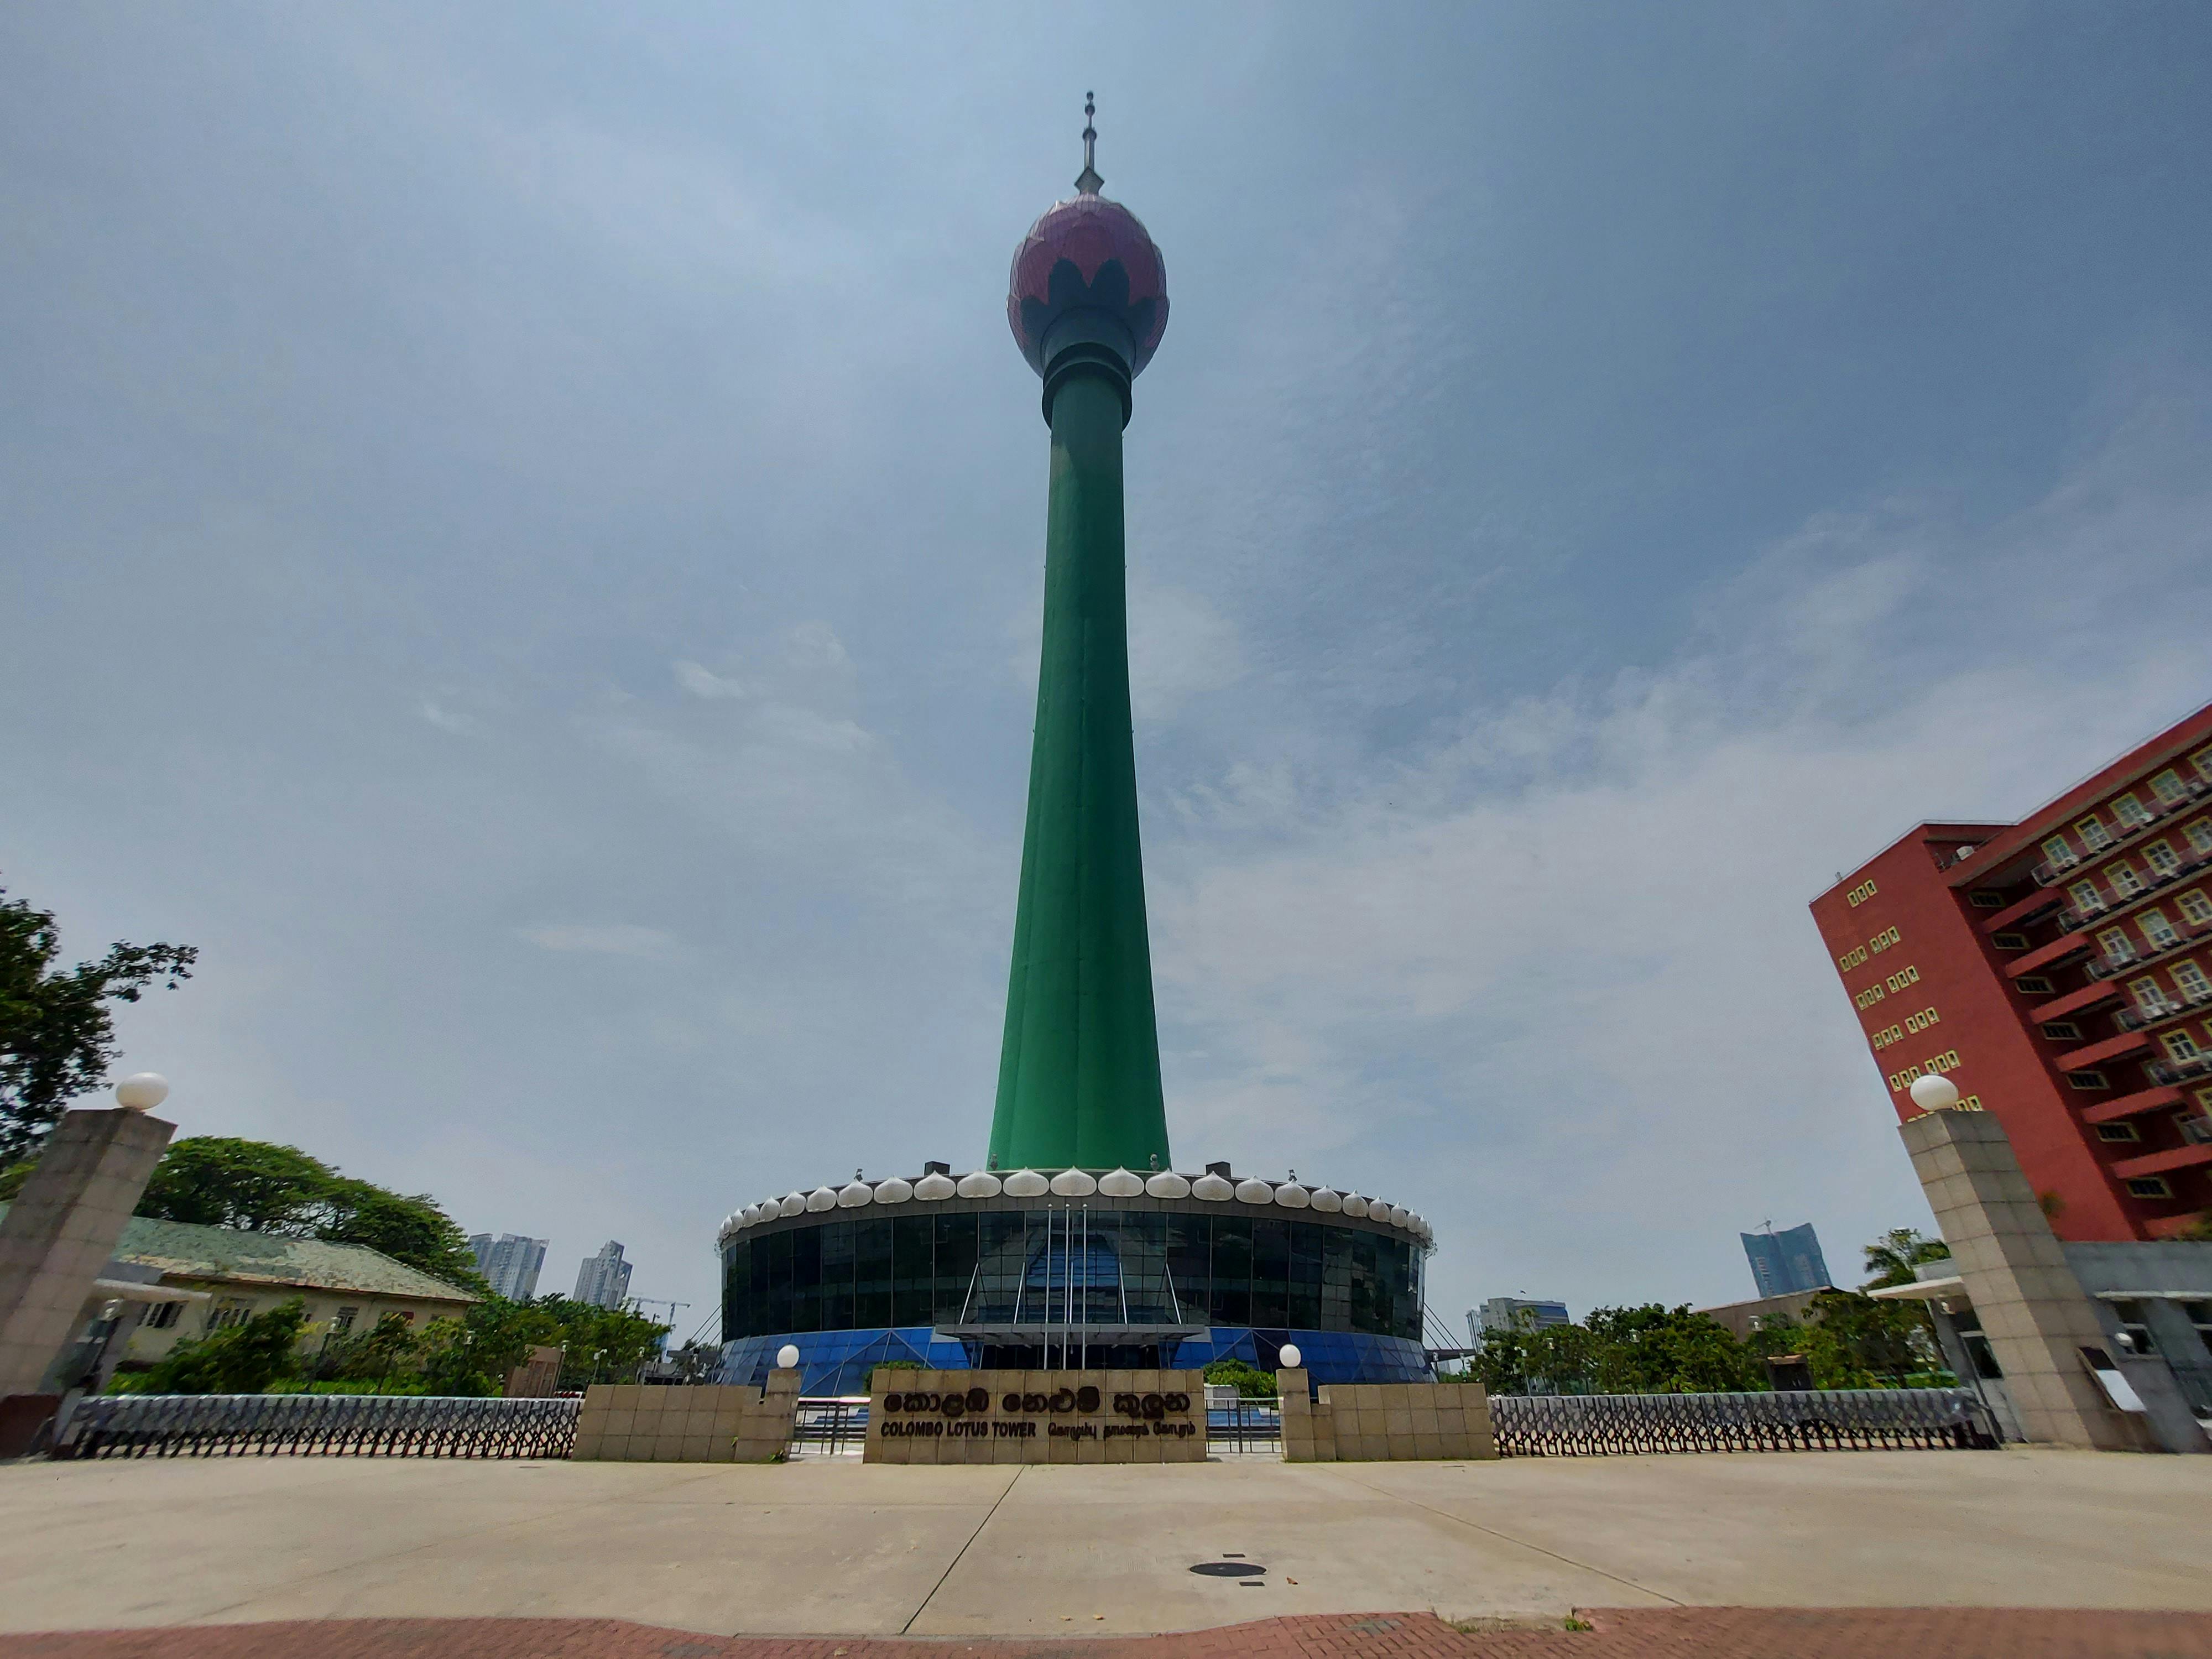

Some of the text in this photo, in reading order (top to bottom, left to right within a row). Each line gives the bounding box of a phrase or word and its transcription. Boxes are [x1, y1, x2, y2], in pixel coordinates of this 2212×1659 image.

[881, 1421, 1036, 1438] COLOMBO LOTUS TOWER
